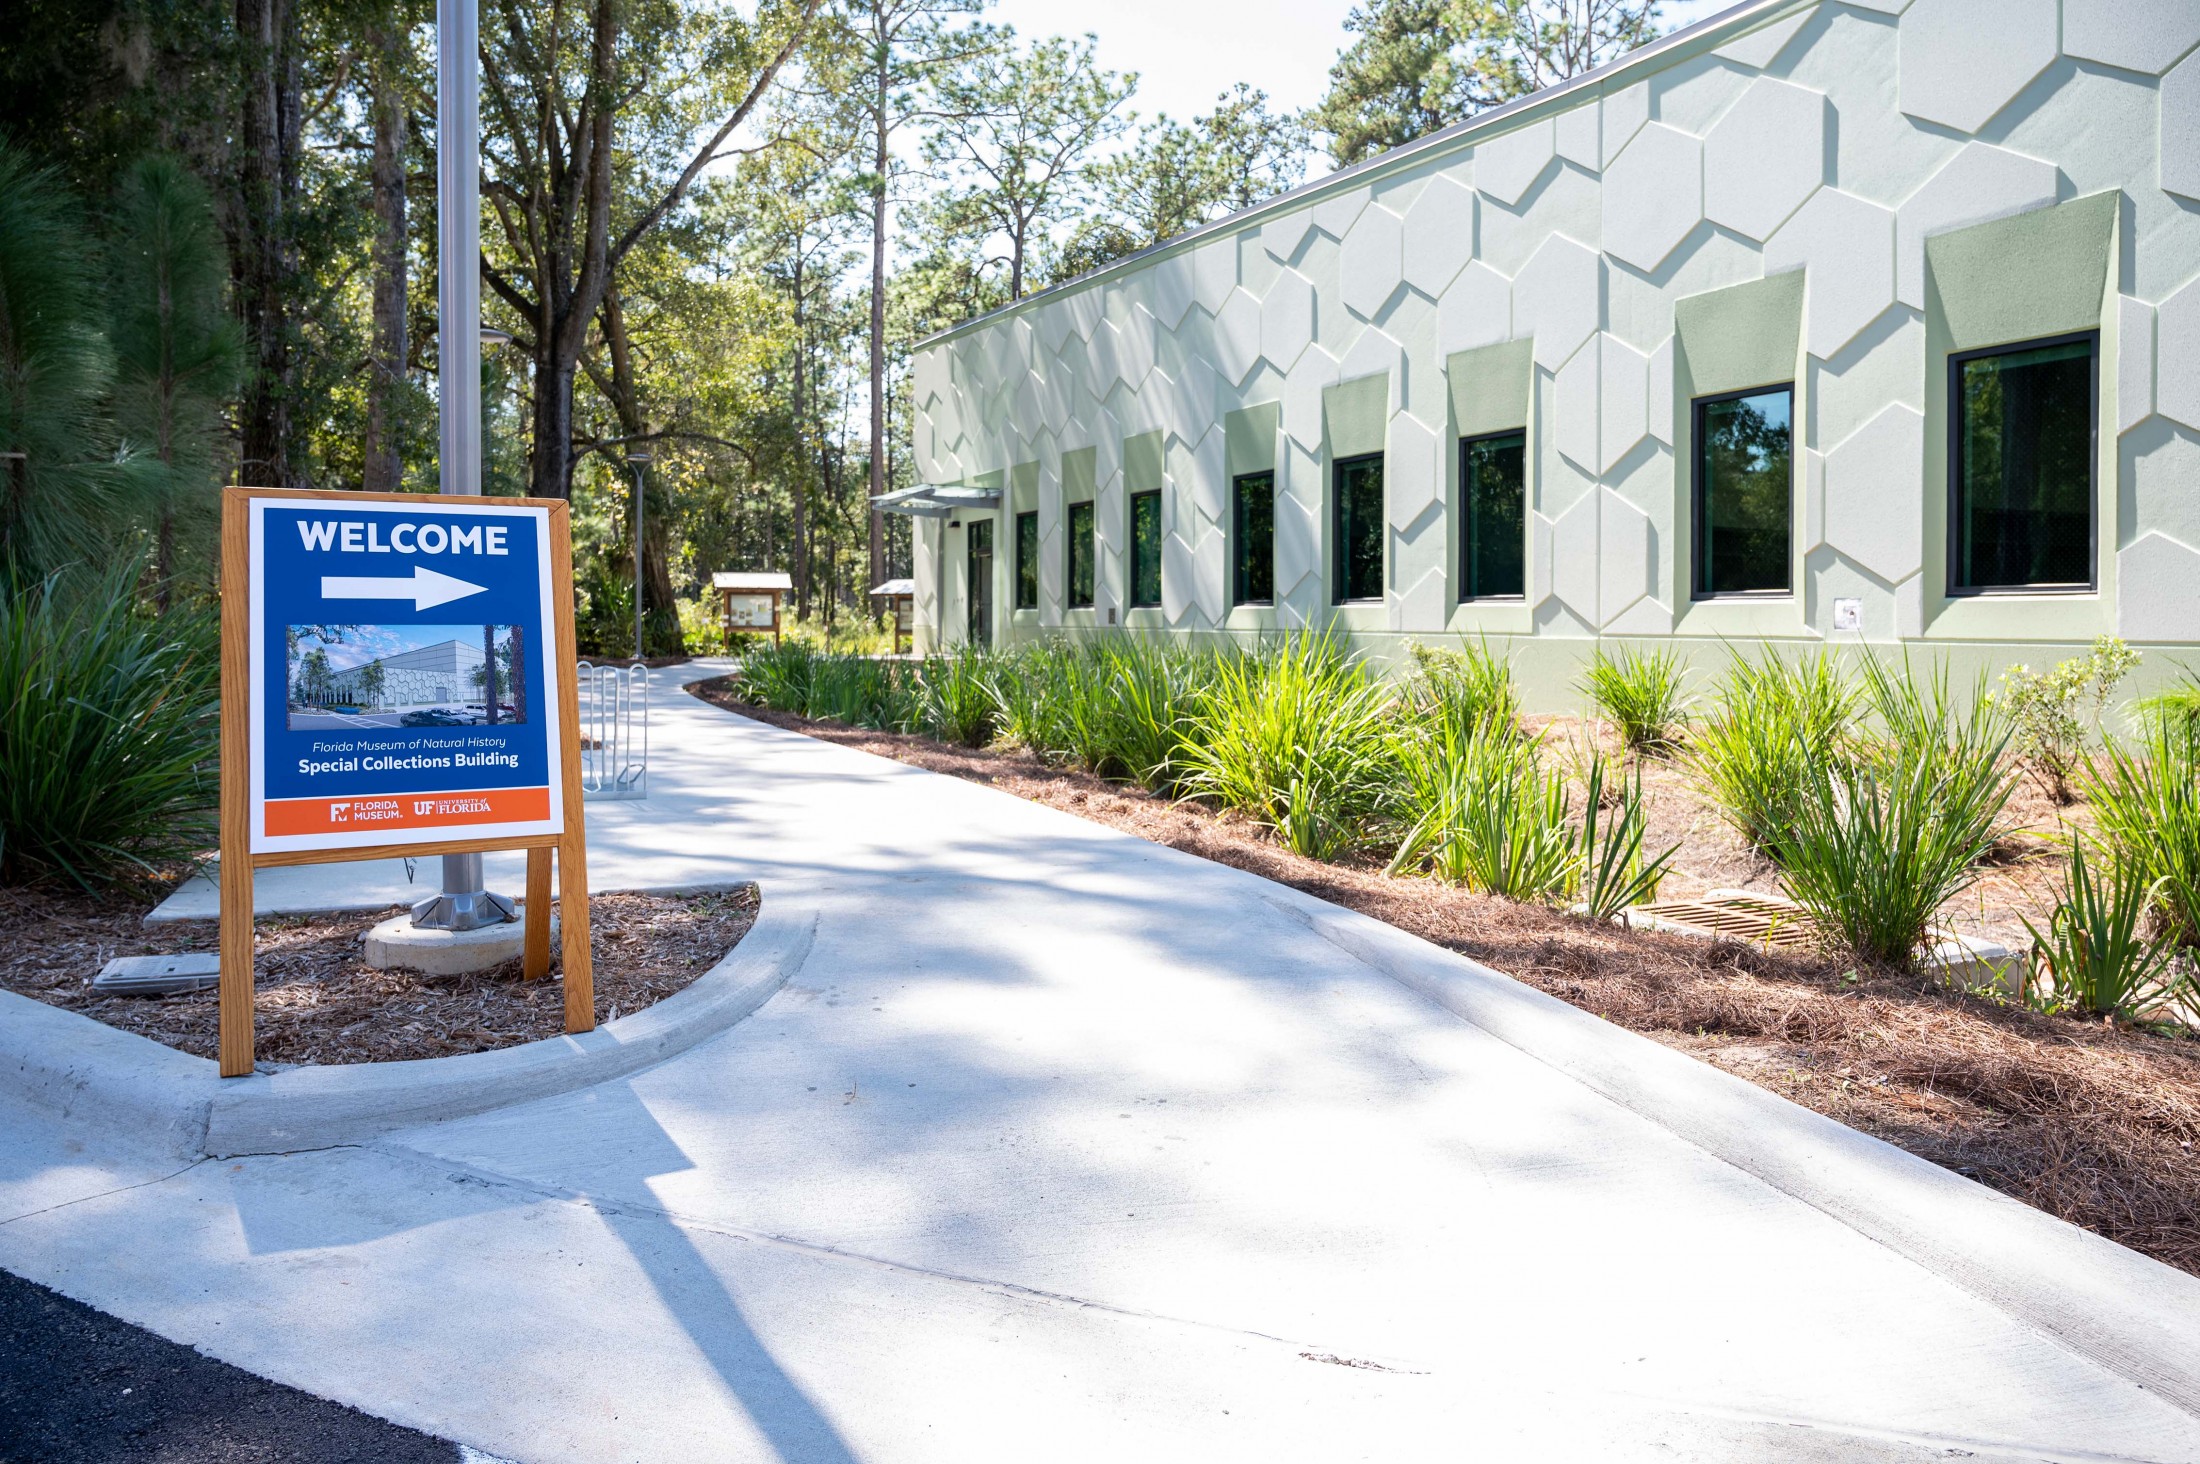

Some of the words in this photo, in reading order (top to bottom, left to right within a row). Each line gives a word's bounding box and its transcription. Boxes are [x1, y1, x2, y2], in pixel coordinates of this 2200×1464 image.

[297, 520, 509, 556] WELCOME
[312, 742, 353, 753] Florida
[357, 740, 406, 751] Museum
[408, 739, 421, 749] of
[423, 738, 464, 748] Natural
[467, 736, 506, 748] History
[298, 757, 358, 776] Special
[362, 754, 451, 771] Collections
[455, 751, 519, 768] Building
[354, 801, 399, 811] FLORIDA
[413, 801, 435, 816] UF
[439, 802, 492, 815] FLORIDA
